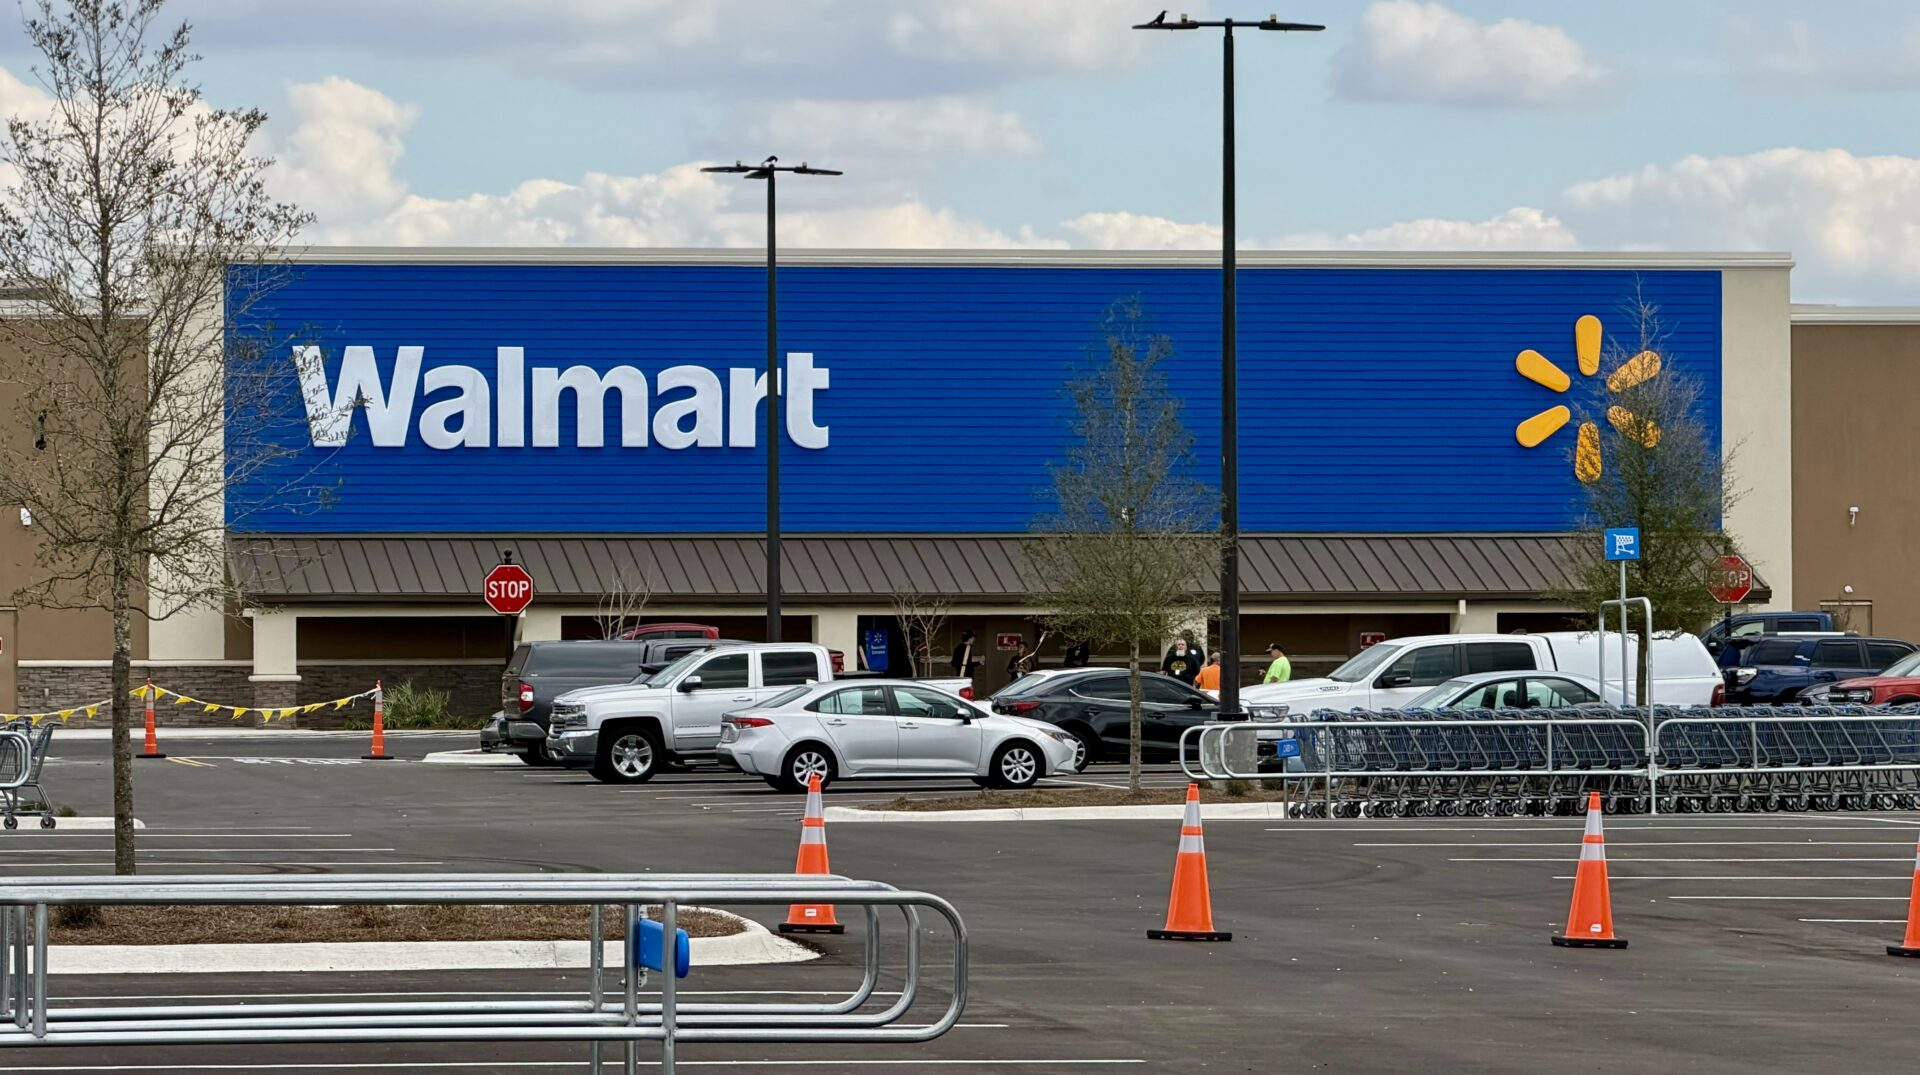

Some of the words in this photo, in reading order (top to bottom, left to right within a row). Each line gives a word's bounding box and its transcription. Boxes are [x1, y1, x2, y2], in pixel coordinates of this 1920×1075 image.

[292, 345, 829, 450] Walmart
[1709, 570, 1749, 588] OP
[488, 580, 530, 599] STOP
